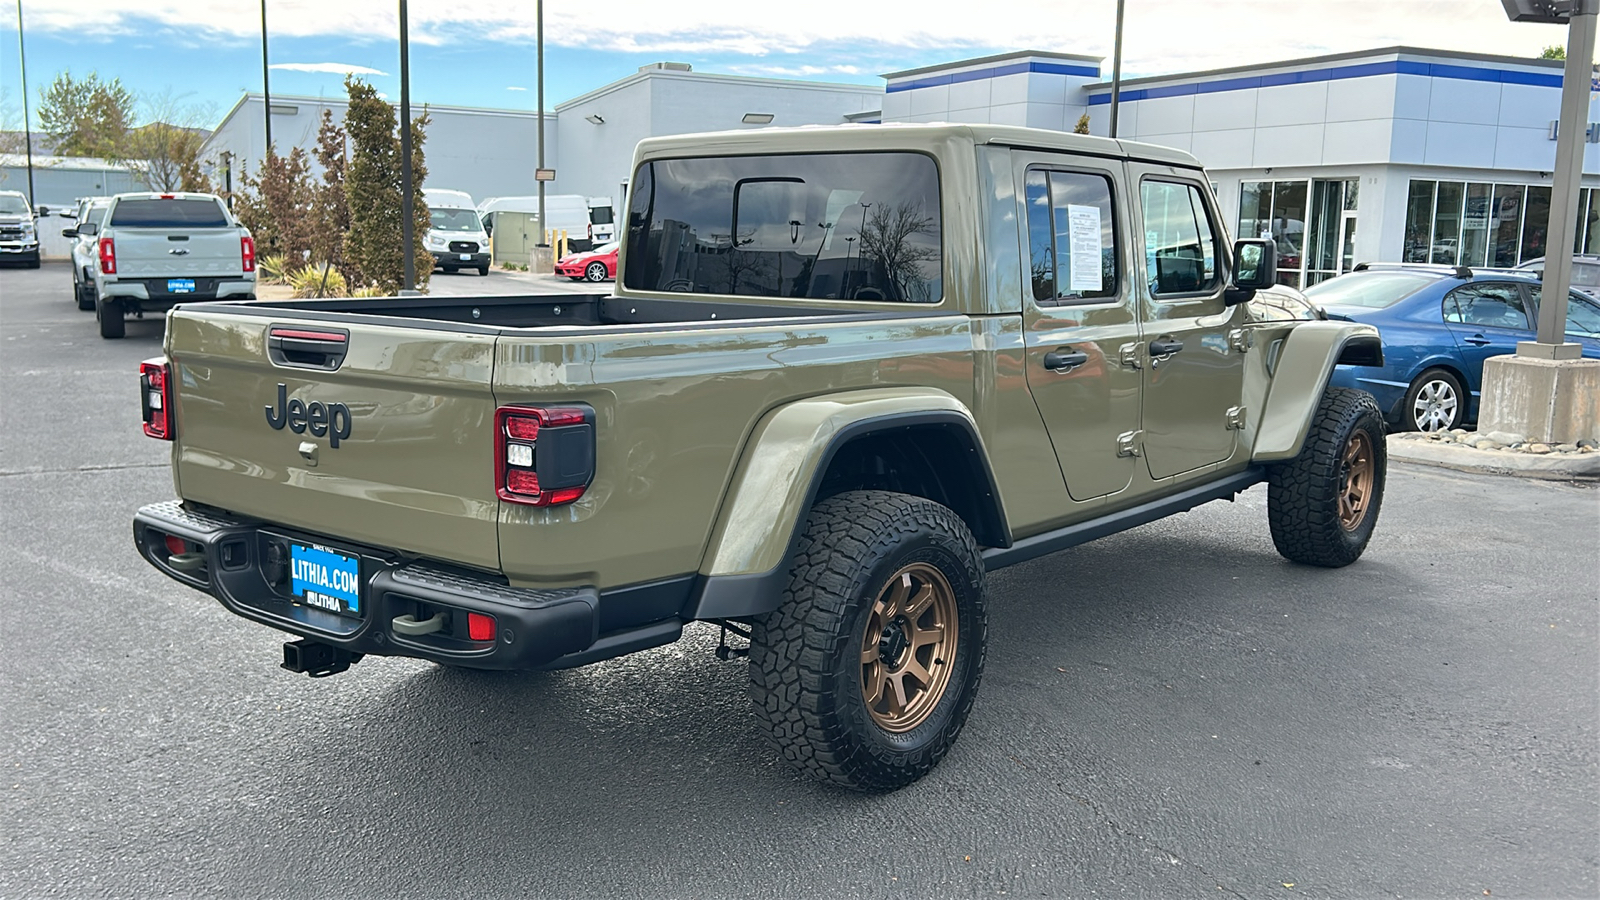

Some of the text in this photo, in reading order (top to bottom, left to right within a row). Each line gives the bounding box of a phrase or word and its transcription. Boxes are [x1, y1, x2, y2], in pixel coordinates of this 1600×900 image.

[265, 383, 352, 449] Jeep
[291, 557, 358, 595] LITHIA.COM
[315, 594, 341, 612] LITHIA
